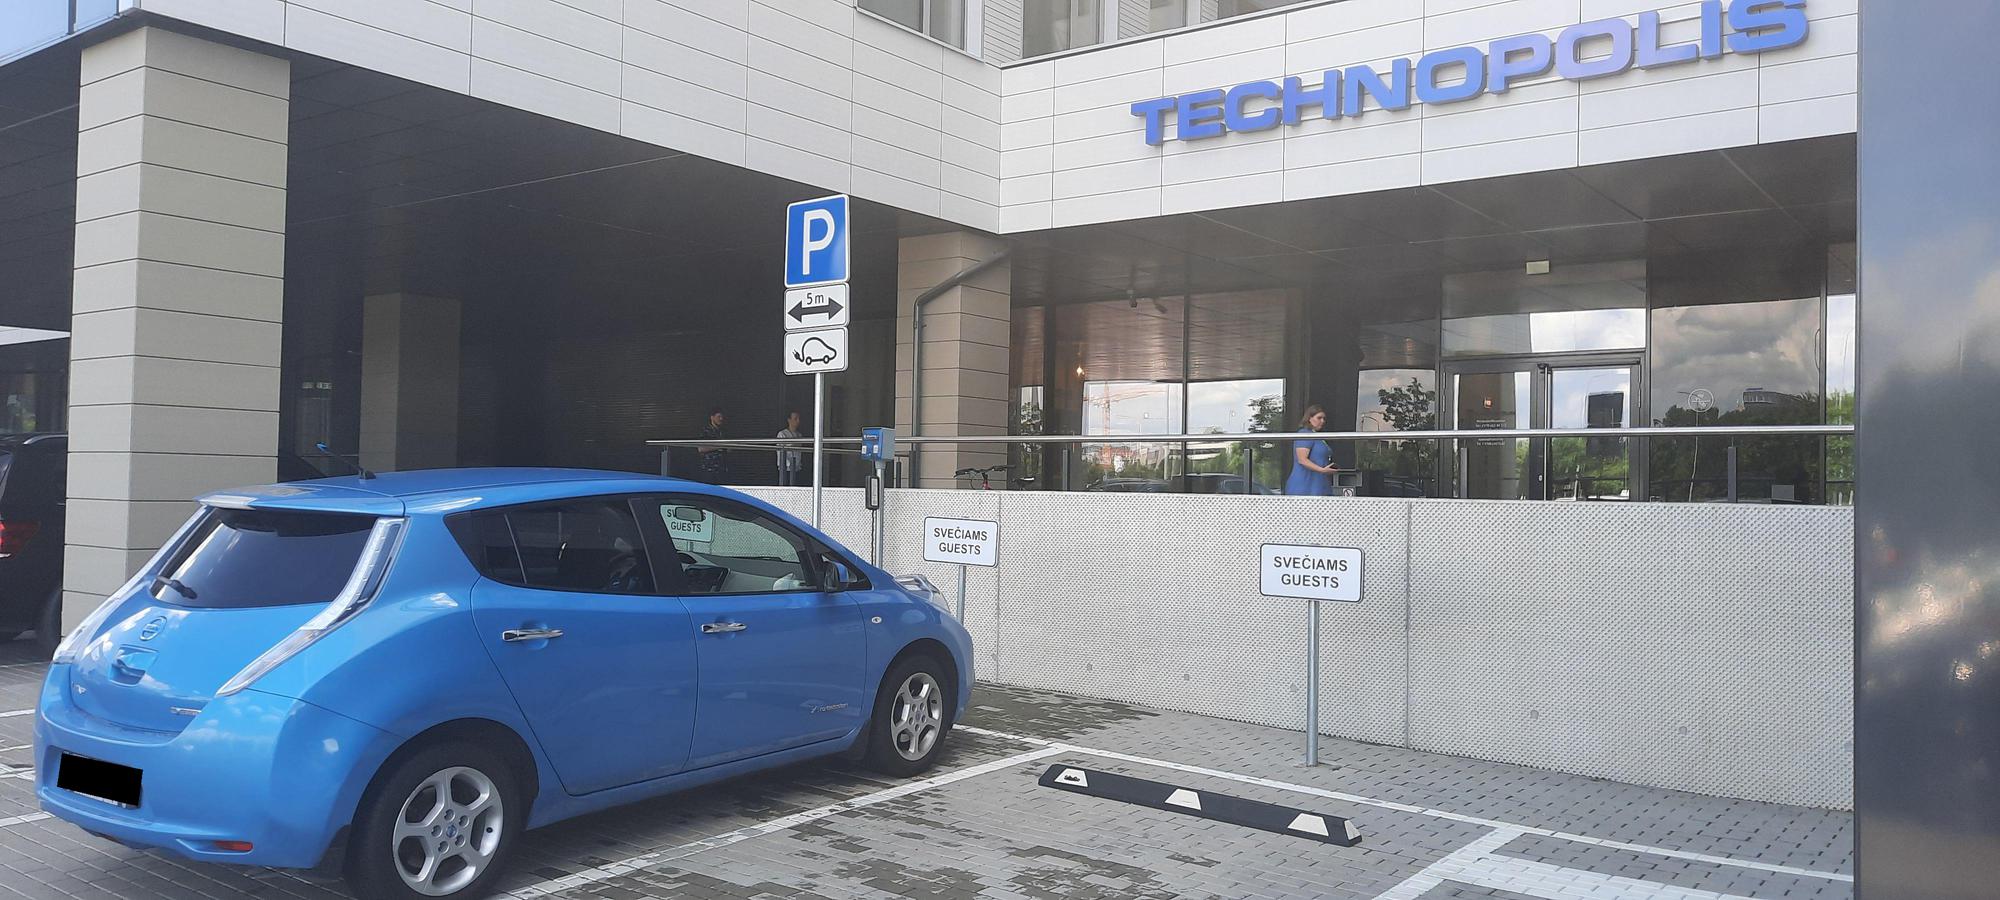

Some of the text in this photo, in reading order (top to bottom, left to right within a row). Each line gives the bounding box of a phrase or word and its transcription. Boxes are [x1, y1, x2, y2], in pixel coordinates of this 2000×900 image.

[1131, 0, 1809, 146] TECHNOPOLIS
[802, 208, 836, 276] P
[670, 521, 702, 533] GUESTS
[933, 526, 988, 541] SVEČIAMS
[938, 542, 981, 555] GUESTS
[1273, 554, 1348, 572] SVEČIAMS
[1281, 573, 1339, 589] GUESTS
